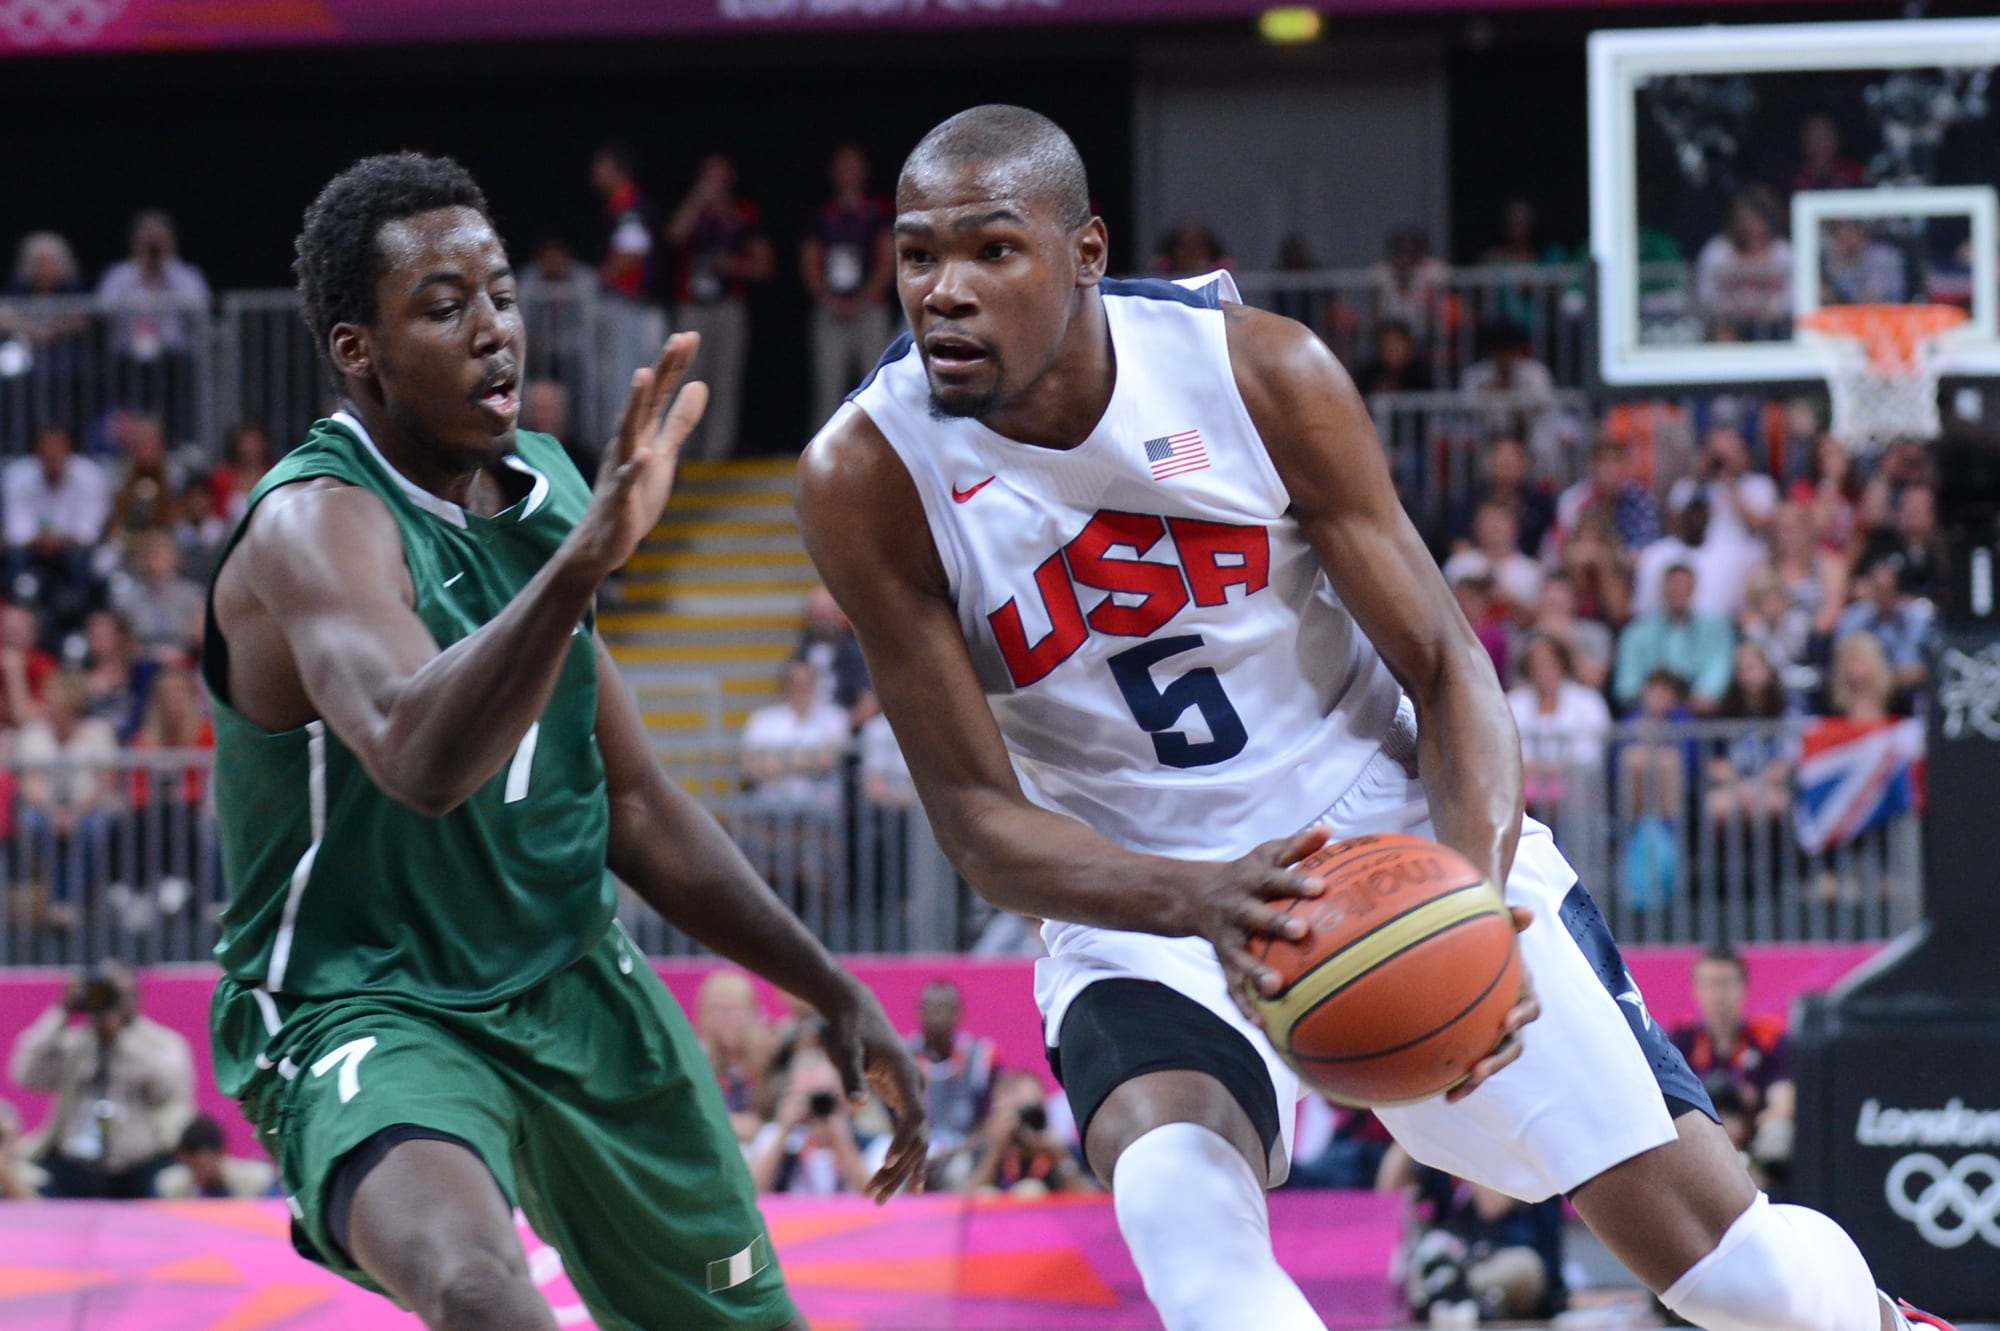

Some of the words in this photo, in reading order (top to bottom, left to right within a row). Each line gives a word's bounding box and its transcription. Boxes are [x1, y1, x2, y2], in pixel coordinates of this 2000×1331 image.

[987, 509, 1270, 689] USA
[1106, 634, 1249, 769] 5
[309, 1035, 378, 1105] 7
